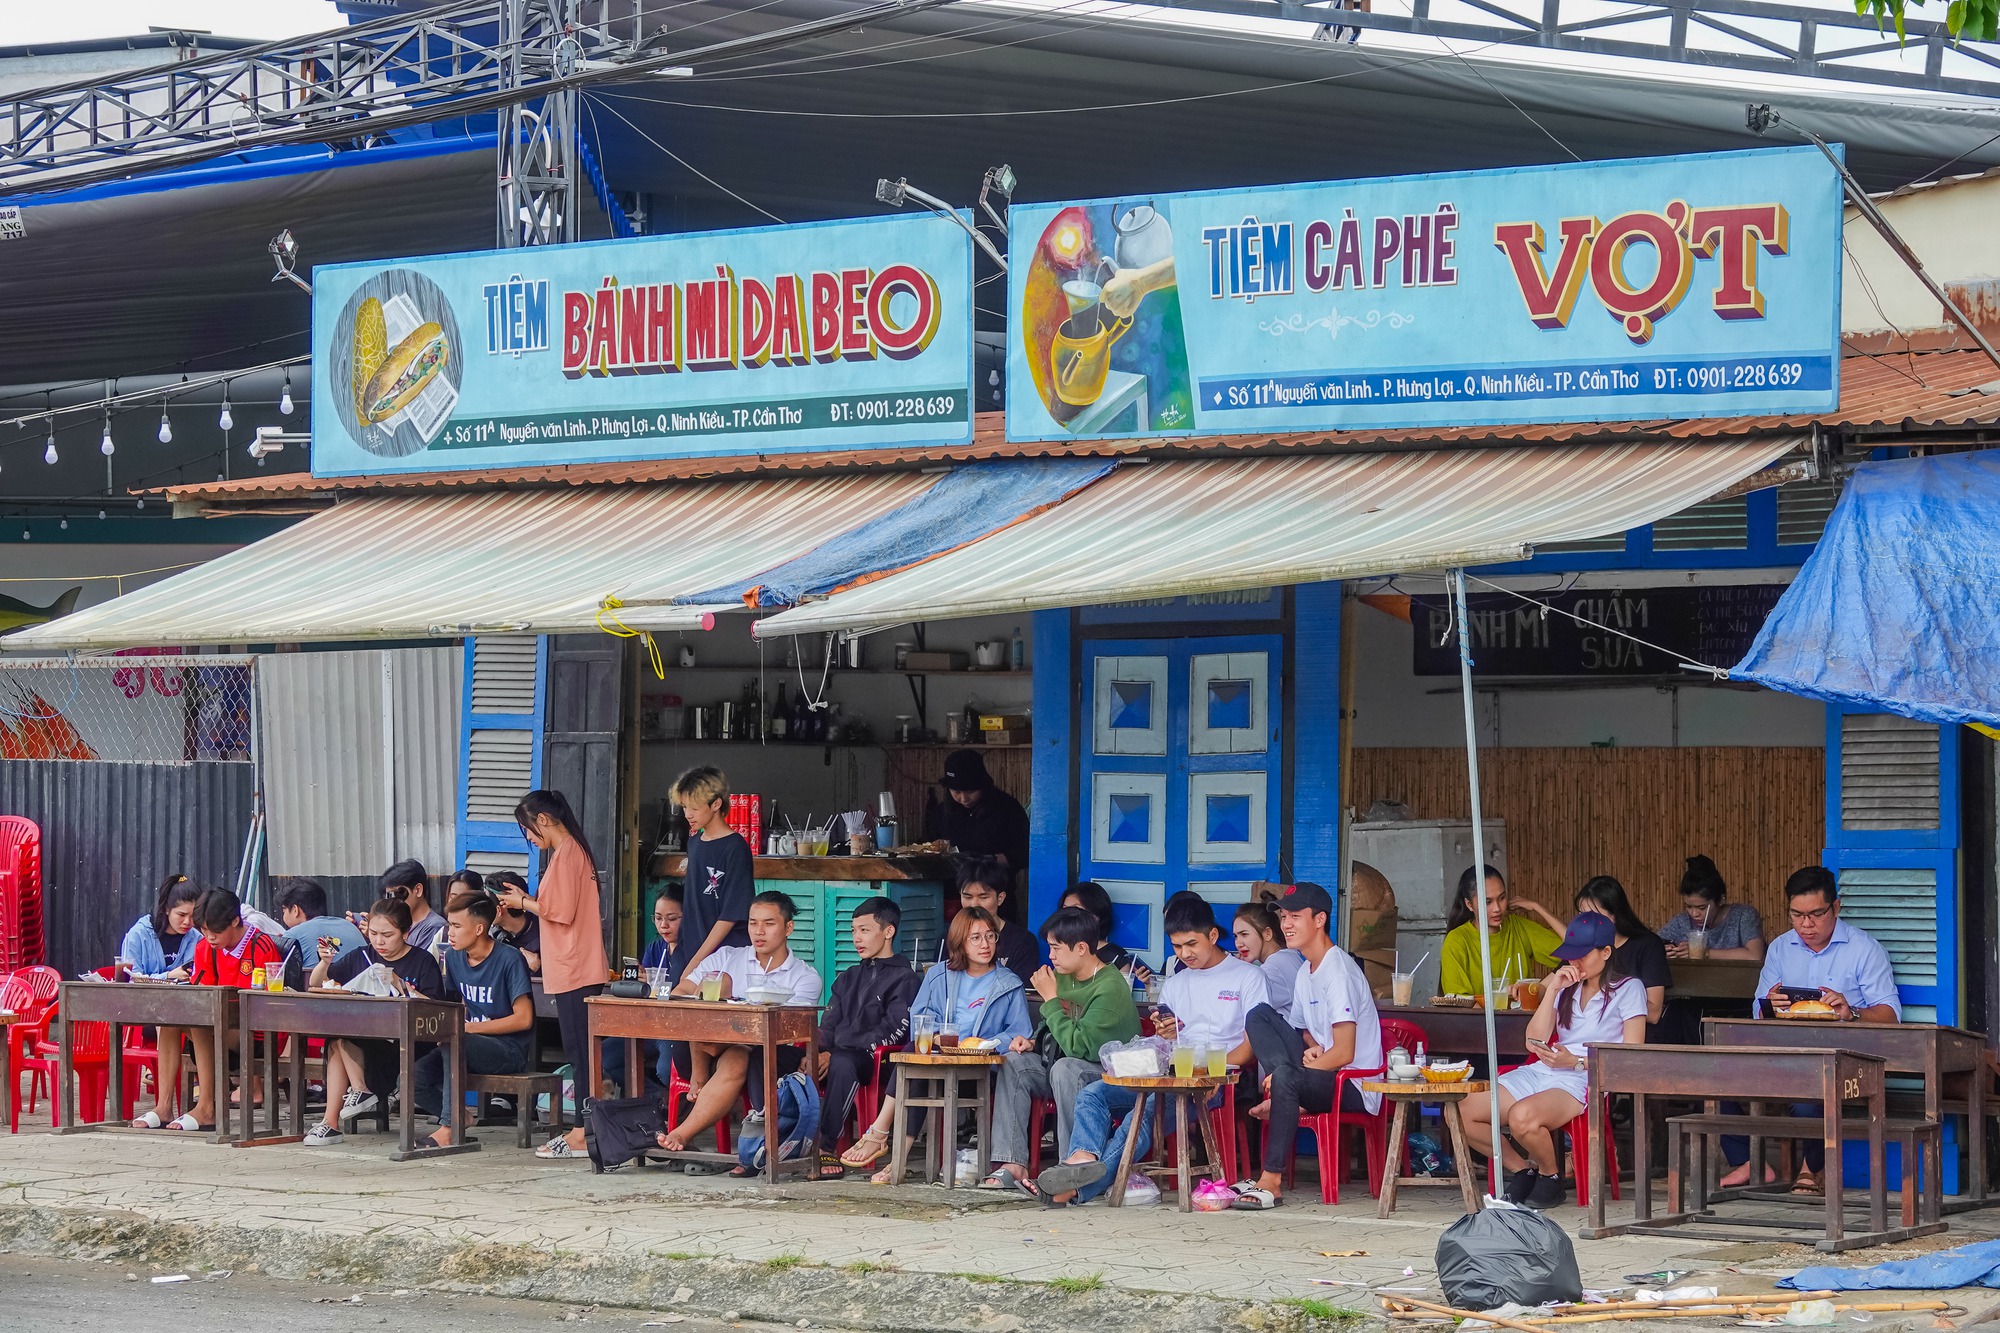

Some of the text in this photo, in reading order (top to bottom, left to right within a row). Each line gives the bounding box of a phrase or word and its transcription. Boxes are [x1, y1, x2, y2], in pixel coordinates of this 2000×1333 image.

[1202, 202, 1459, 303] TIỆM CÀ PHÊ
[1493, 198, 1788, 345] VỢT
[483, 273, 549, 358] TIỆM
[562, 262, 941, 379] BÁNH MÌ DA BEO
[1228, 384, 1251, 405] Số
[1275, 382, 1318, 404] Nguyễn
[1320, 383, 1343, 399] văn
[1345, 380, 1372, 399] Linh
[1434, 378, 1453, 398] Lợi
[1579, 369, 1608, 390] Cần
[1611, 370, 1639, 388] Thơ
[1654, 368, 1682, 389] ĐT:
[455, 425, 472, 443] Số
[500, 422, 539, 443] Nguyễn
[541, 422, 562, 438] văn
[632, 416, 648, 435] Lợi
[752, 407, 776, 427] Cần
[778, 407, 802, 424] Thơ
[831, 403, 853, 421] ĐT:
[626, 969, 637, 979] 34
[660, 986, 670, 997] 32
